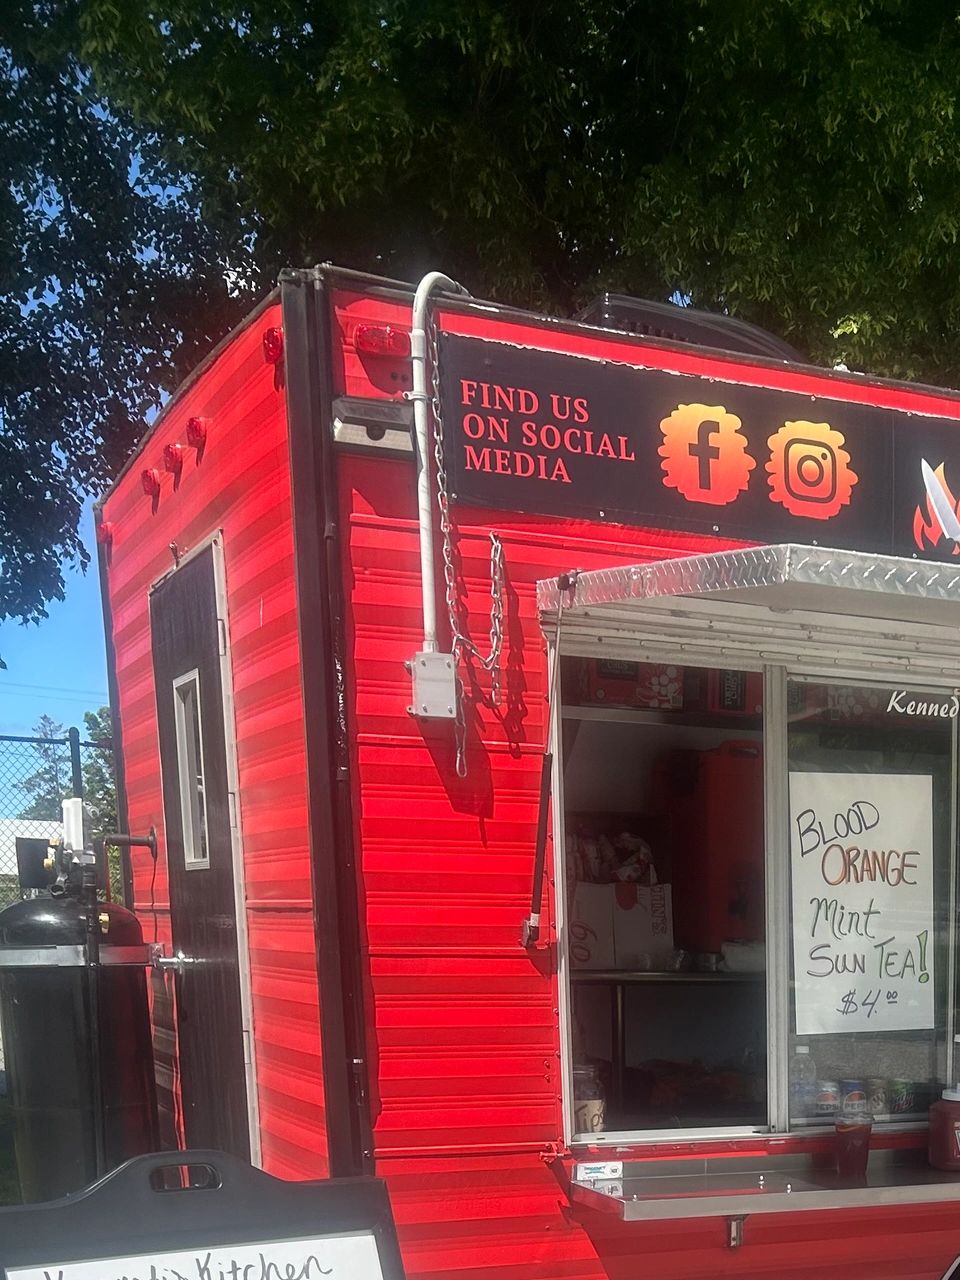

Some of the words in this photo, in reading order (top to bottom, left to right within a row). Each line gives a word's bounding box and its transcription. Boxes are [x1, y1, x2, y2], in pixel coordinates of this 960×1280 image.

[459, 378, 540, 415] FIND
[550, 395, 590, 424] US
[462, 413, 510, 443] ON
[522, 419, 636, 461] SOCIAL
[464, 444, 573, 484] MEDIA
[796, 800, 880, 857] BLOOD
[821, 843, 921, 887] ORANGE
[810, 897, 881, 940] Mint
[873, 929, 930, 984] TEA!
